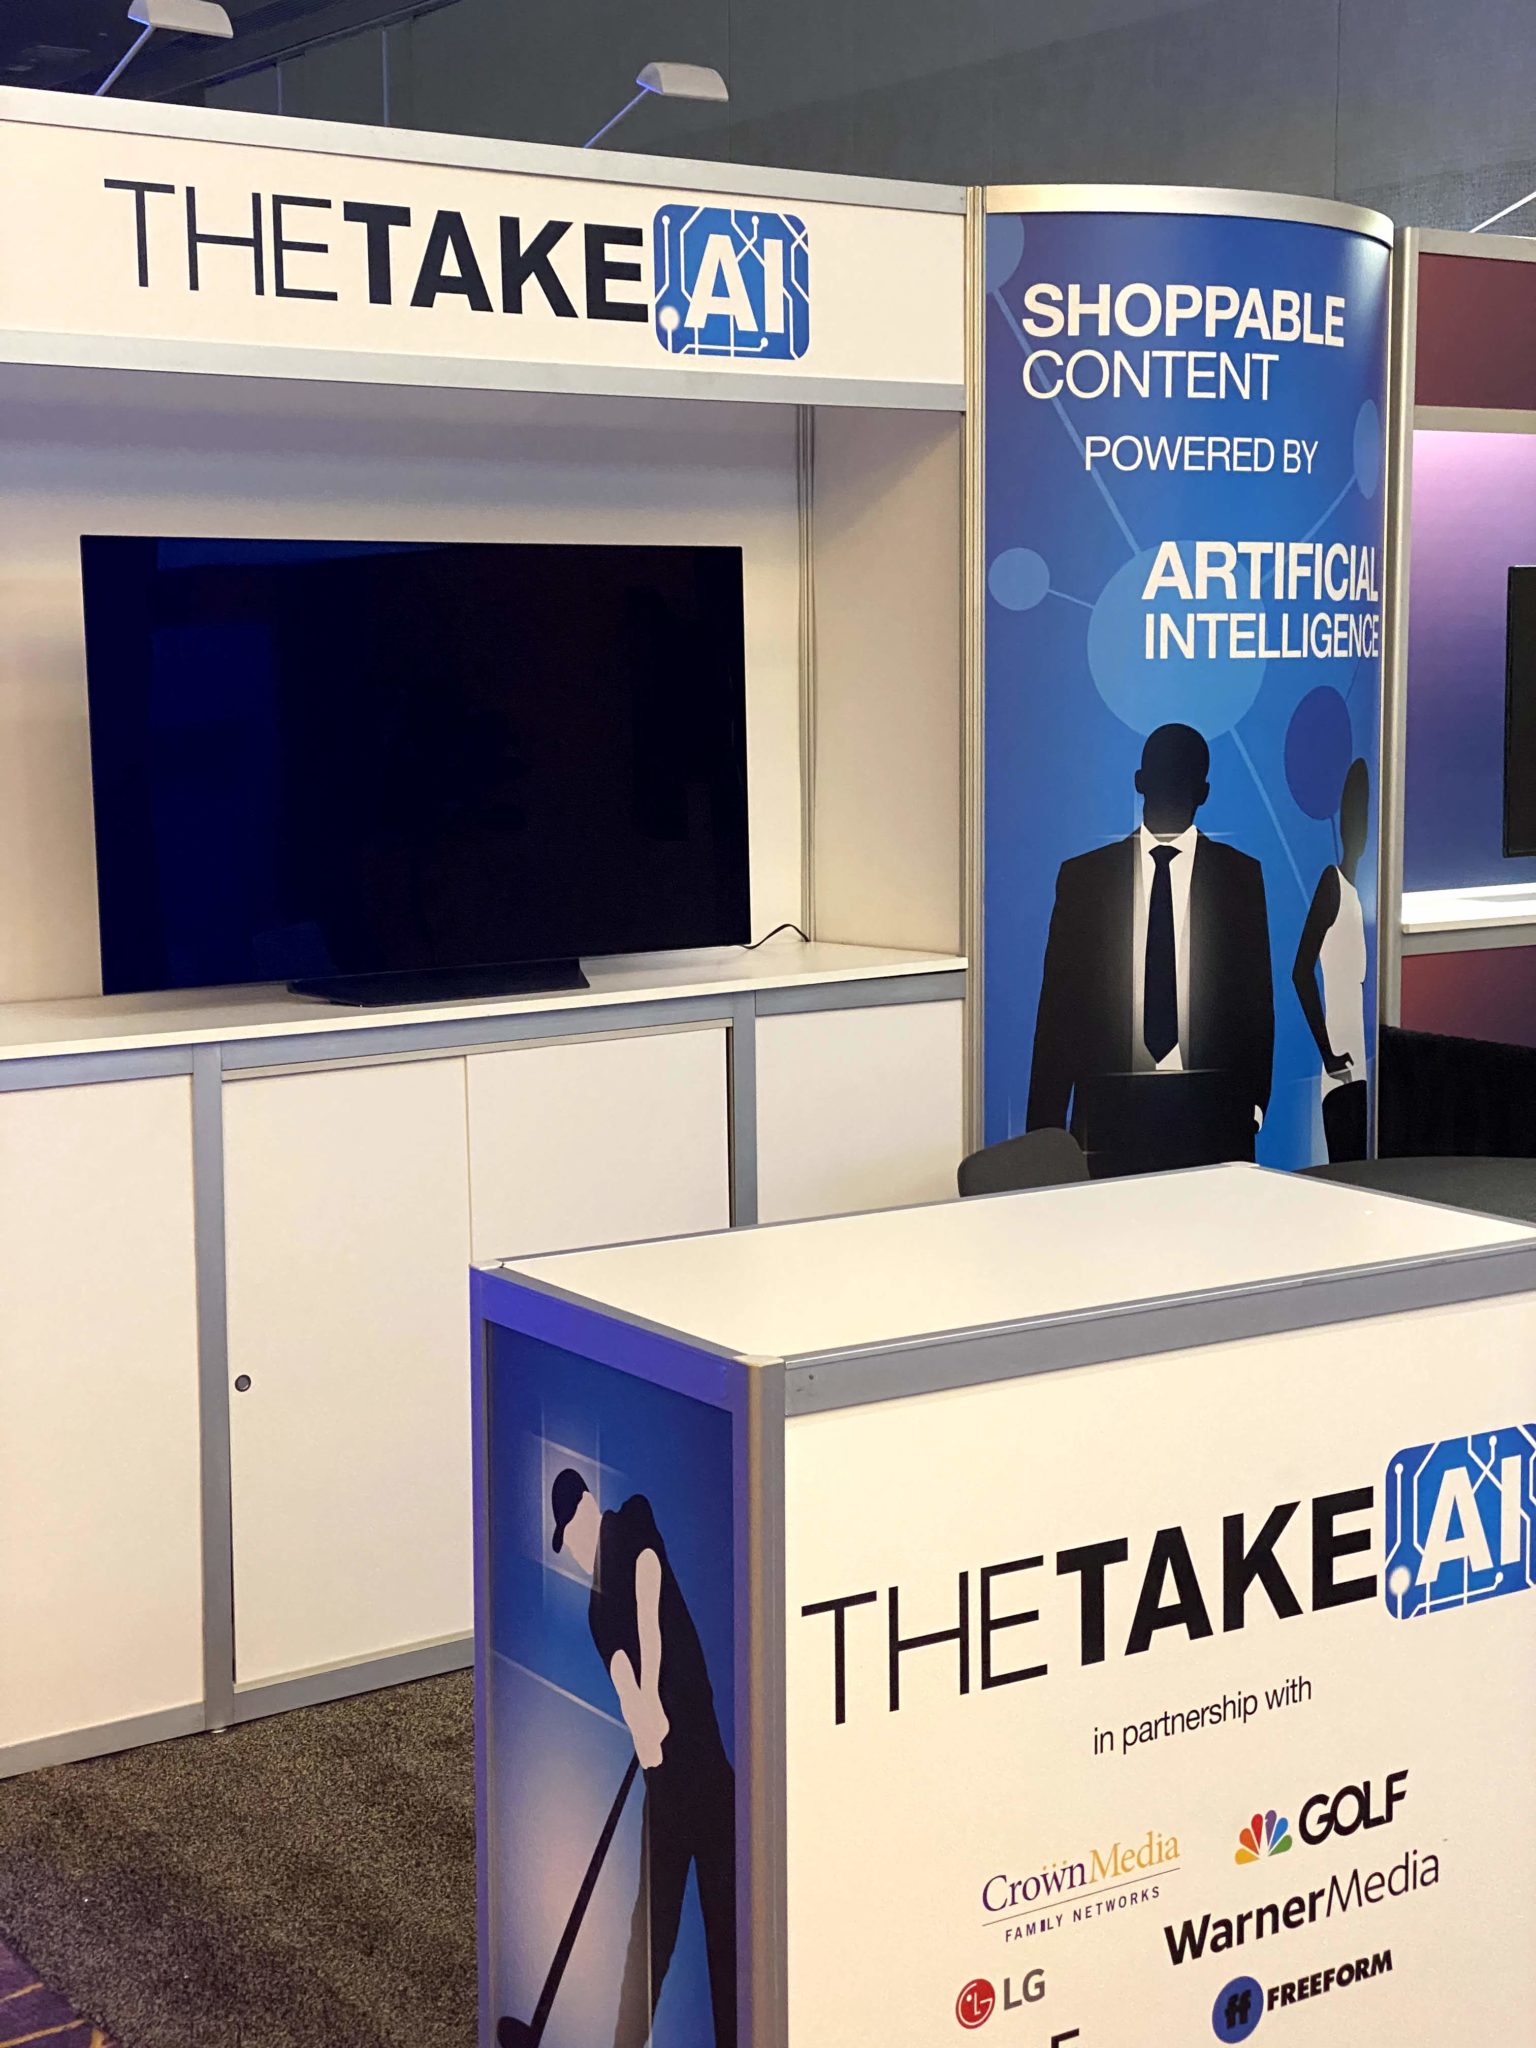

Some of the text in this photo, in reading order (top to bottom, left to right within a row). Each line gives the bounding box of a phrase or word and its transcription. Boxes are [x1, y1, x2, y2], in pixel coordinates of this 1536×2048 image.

[1022, 283, 1345, 347] SHOPPABLE
[1022, 349, 1279, 400] CONTENT
[1084, 436, 1319, 474] POWERED BY
[1142, 541, 1379, 602] ARTIFICIAL
[1145, 613, 1379, 660] INTELLIGENCE
[1094, 1676, 1313, 1756] in partnership with
[1299, 1770, 1409, 1846] GOLF
[1005, 1886, 1160, 1943] FAMILY NETWORKS
[1003, 1968, 1046, 2011] LG
[1266, 1949, 1393, 2012] FREEFORM
